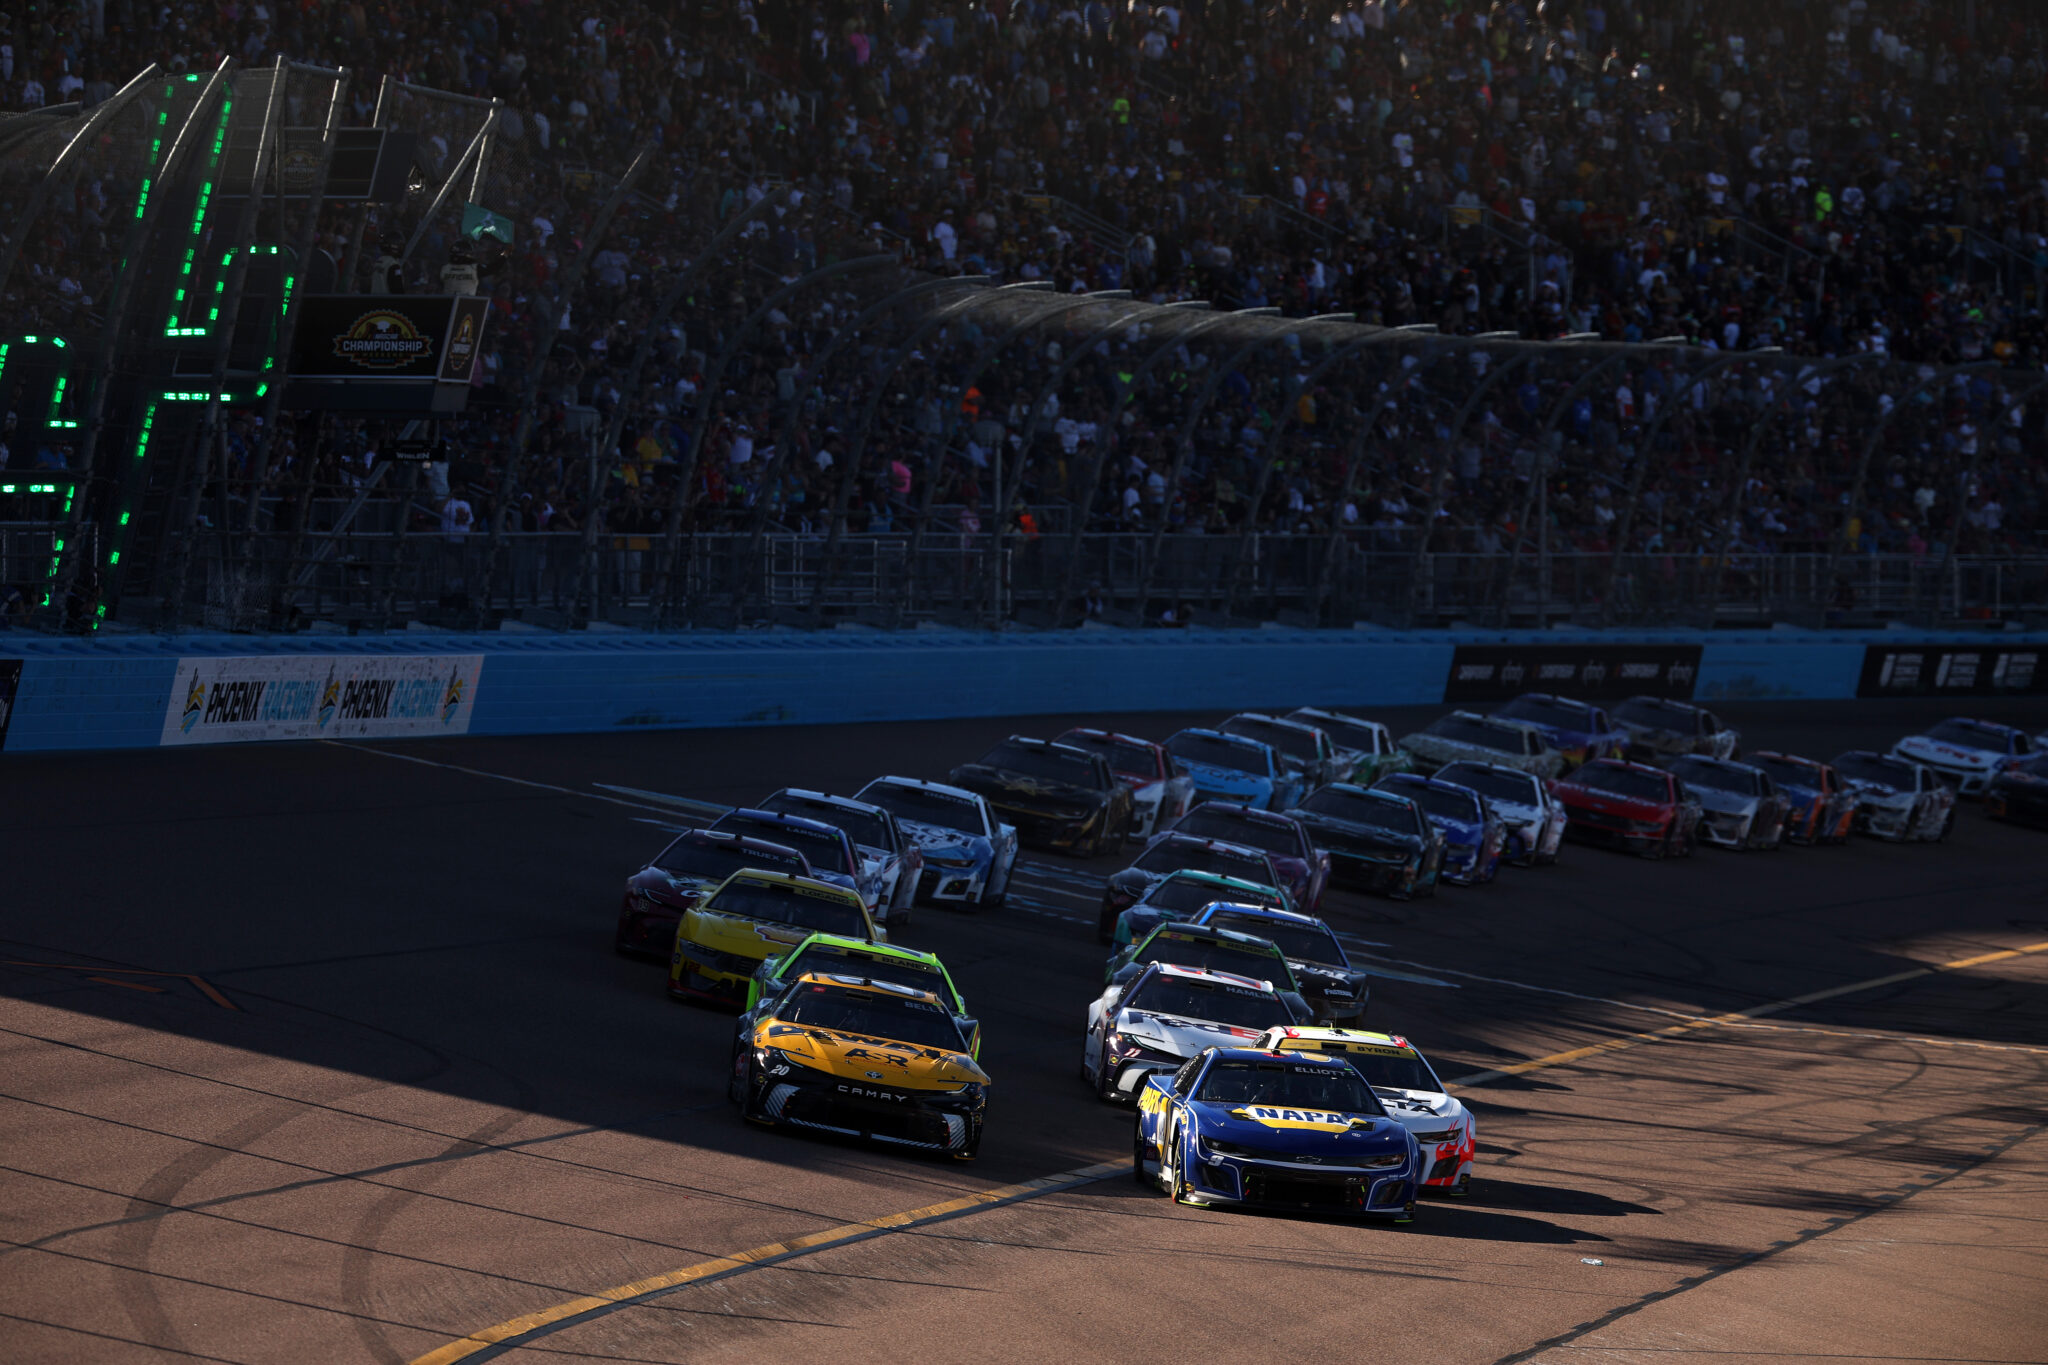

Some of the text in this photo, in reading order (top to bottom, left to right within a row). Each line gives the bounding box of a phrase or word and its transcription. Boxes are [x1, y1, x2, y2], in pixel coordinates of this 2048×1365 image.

[342, 340, 423, 352] CHAMPIONSHIP
[204, 680, 321, 723] PHOENIX RACEWAY
[338, 679, 446, 719] PHOENIX RACEWAY
[786, 826, 831, 840] LARSON
[740, 848, 780, 862] TRUEX
[801, 889, 850, 905] LOGANO
[882, 956, 929, 971] BLANEY
[904, 1001, 937, 1015] BELL
[1357, 1046, 1400, 1056] BYRON
[770, 1064, 790, 1076] 20
[1294, 1066, 1345, 1077] ELLIOTT
[837, 1084, 908, 1103] CAMRY
[1256, 1107, 1348, 1125] NAPA
[1207, 1155, 1225, 1168] 9
